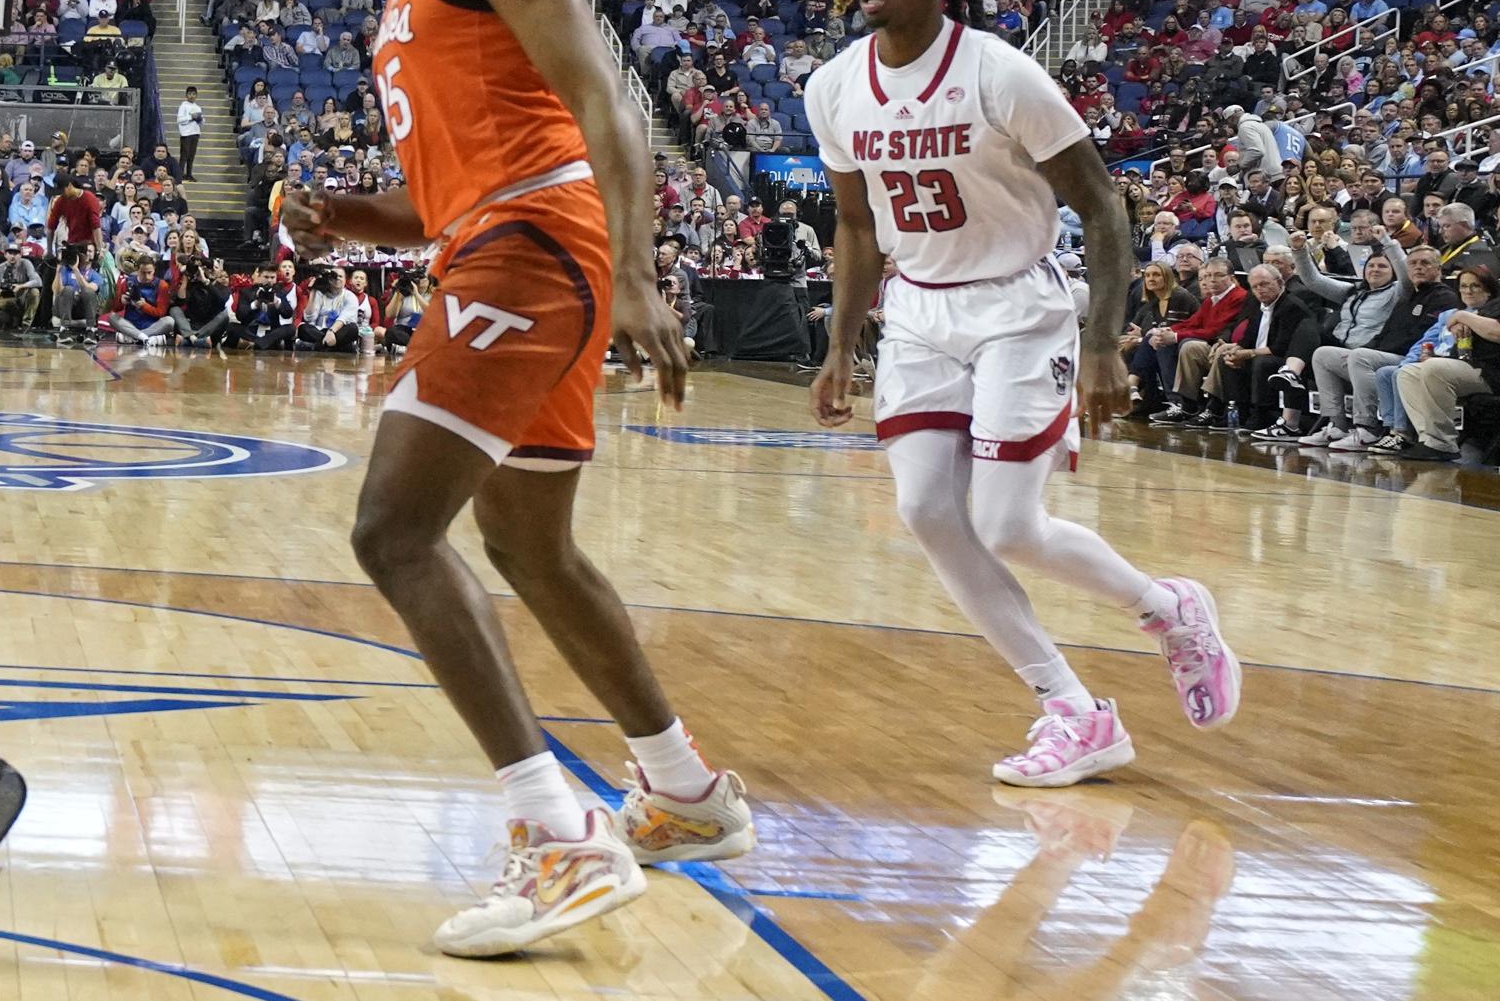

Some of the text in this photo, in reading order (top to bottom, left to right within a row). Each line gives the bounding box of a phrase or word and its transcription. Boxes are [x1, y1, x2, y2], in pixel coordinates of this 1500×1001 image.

[853, 123, 972, 161] NC STATE
[1285, 134, 1301, 155] 15
[880, 168, 968, 233] 23
[445, 294, 534, 351] VT
